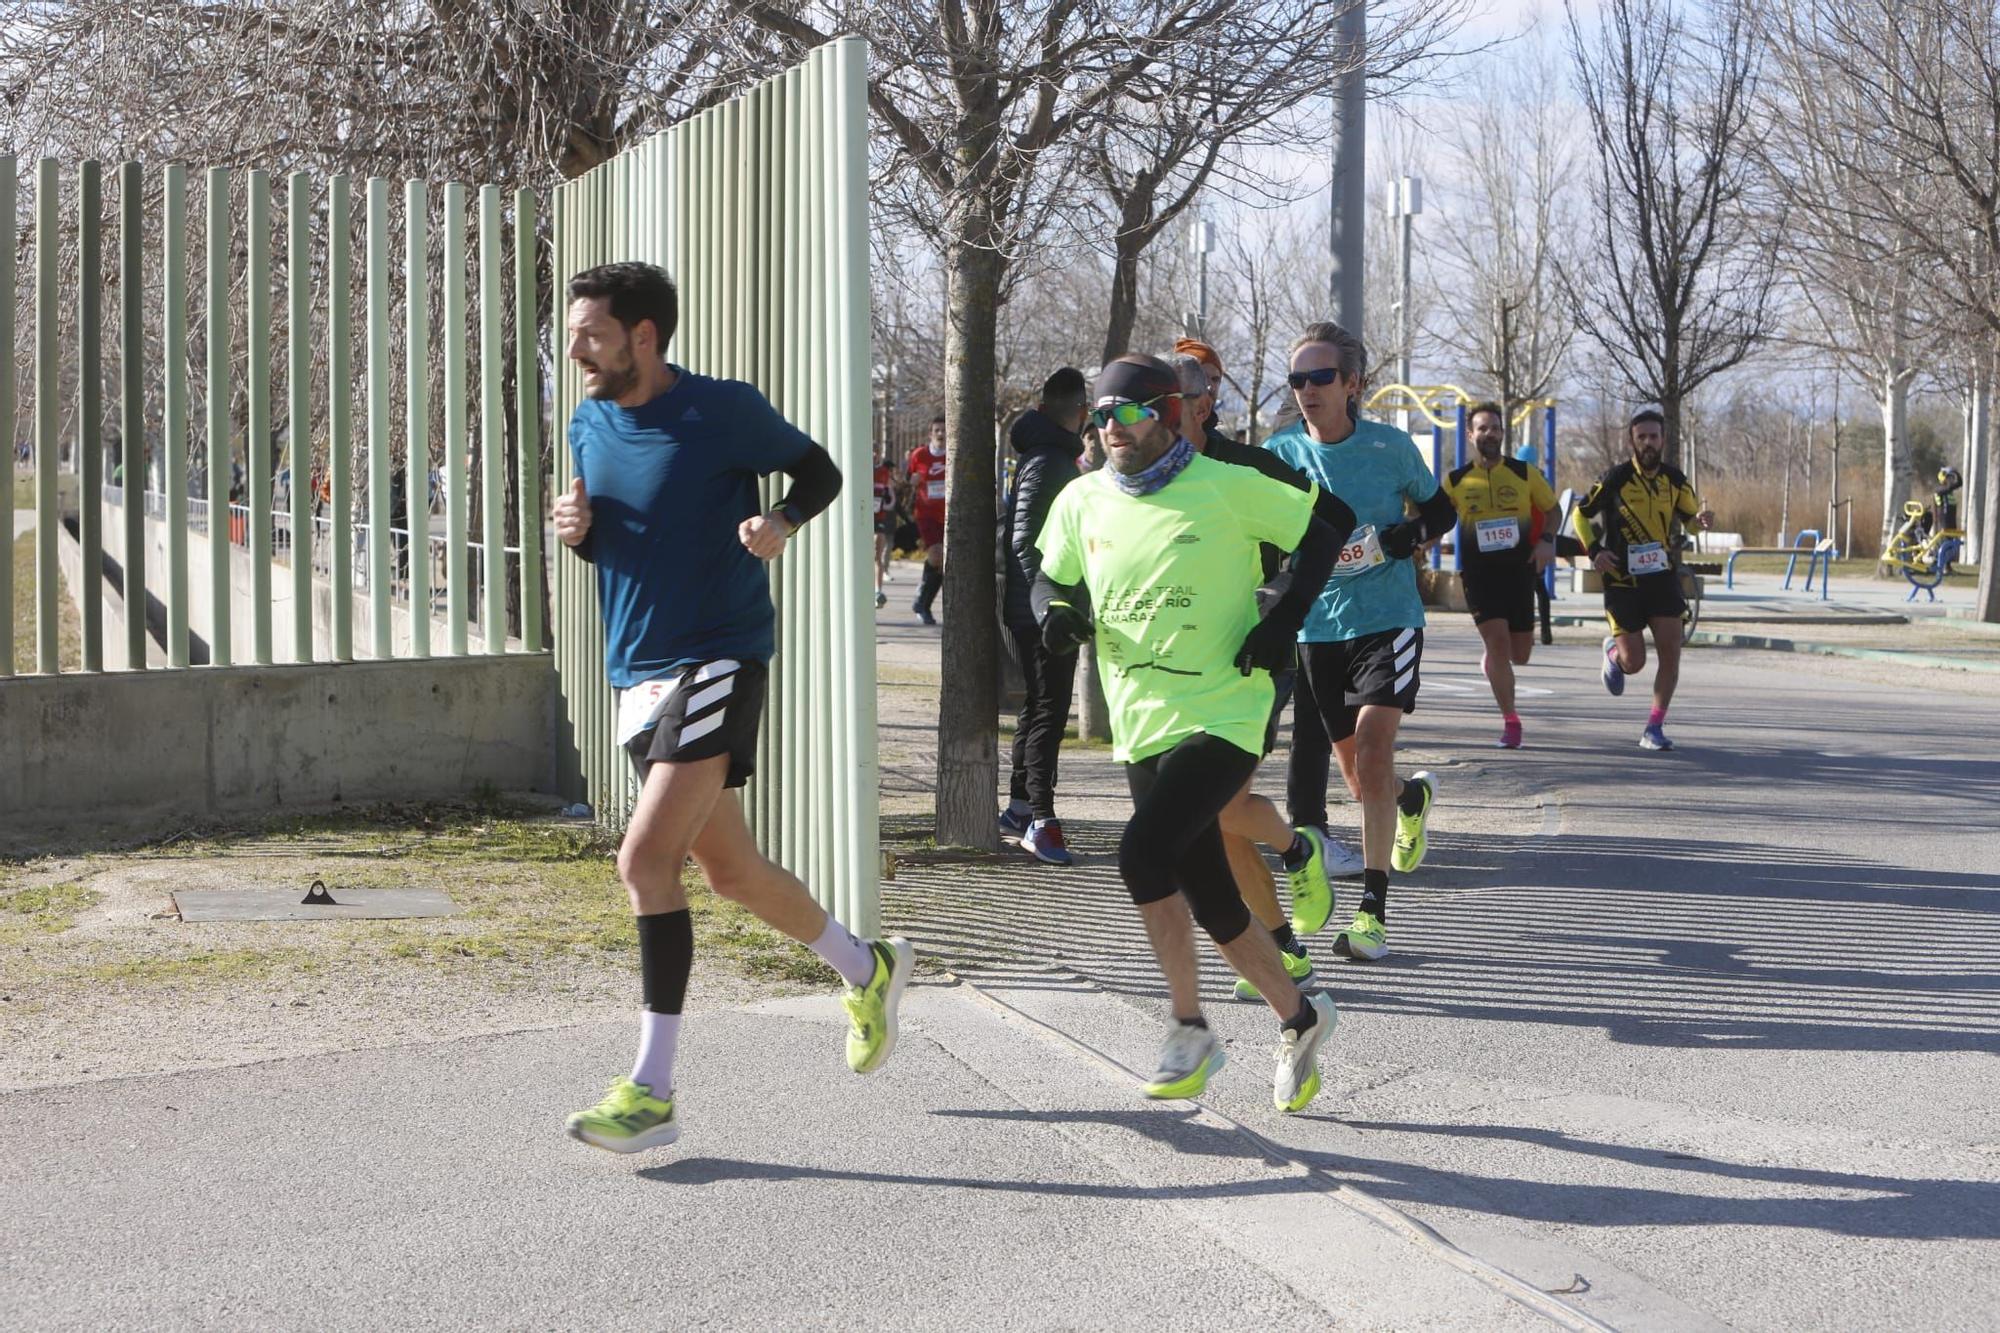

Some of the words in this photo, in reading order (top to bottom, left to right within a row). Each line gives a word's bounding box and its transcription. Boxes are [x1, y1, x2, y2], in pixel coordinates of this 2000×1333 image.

[1485, 528, 1513, 541] 1156
[1638, 552, 1658, 564] 432
[1156, 585, 1198, 597] TRAIL
[1099, 601, 1132, 613] ALLE
[1165, 596, 1192, 608] RÍO
